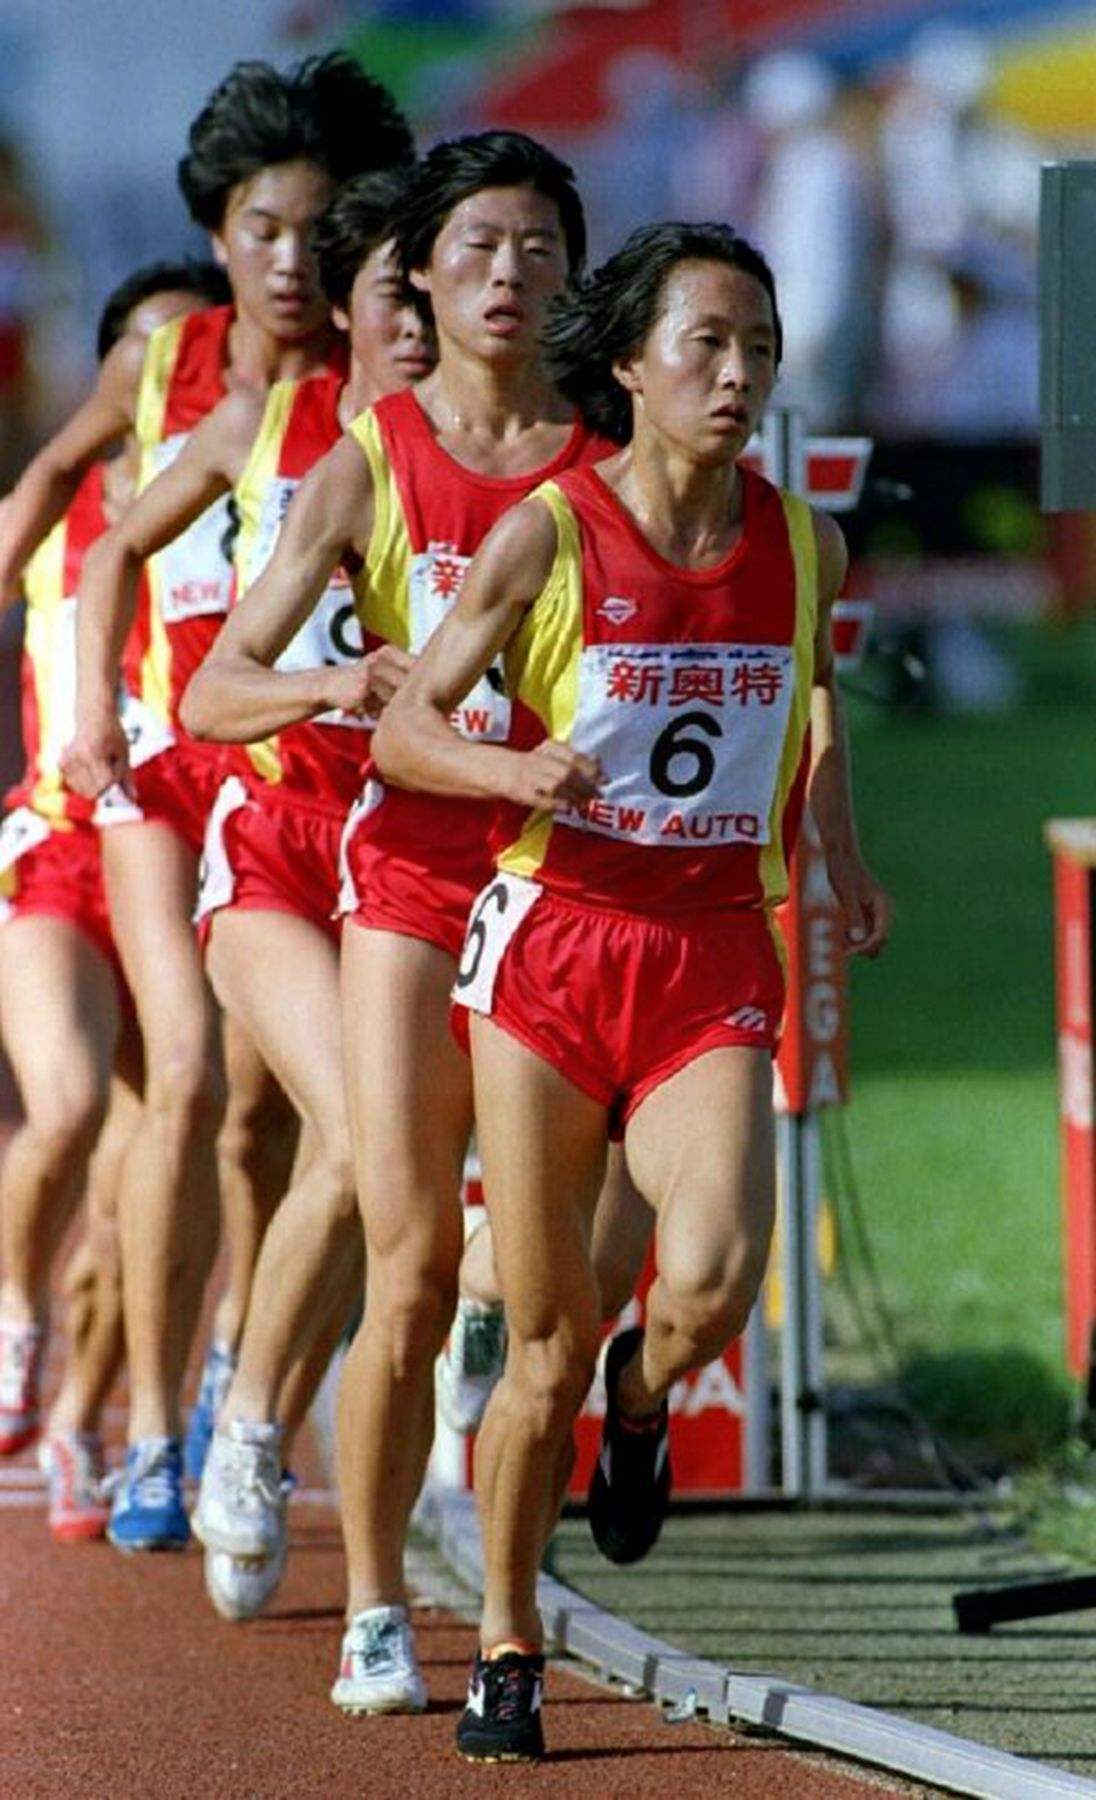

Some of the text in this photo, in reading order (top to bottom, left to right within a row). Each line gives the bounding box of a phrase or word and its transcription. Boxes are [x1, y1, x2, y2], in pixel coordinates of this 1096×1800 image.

[607, 660, 782, 706] 新奥特
[650, 711, 722, 798] 6
[660, 812, 760, 839] AUTO
[457, 883, 508, 988] 6
